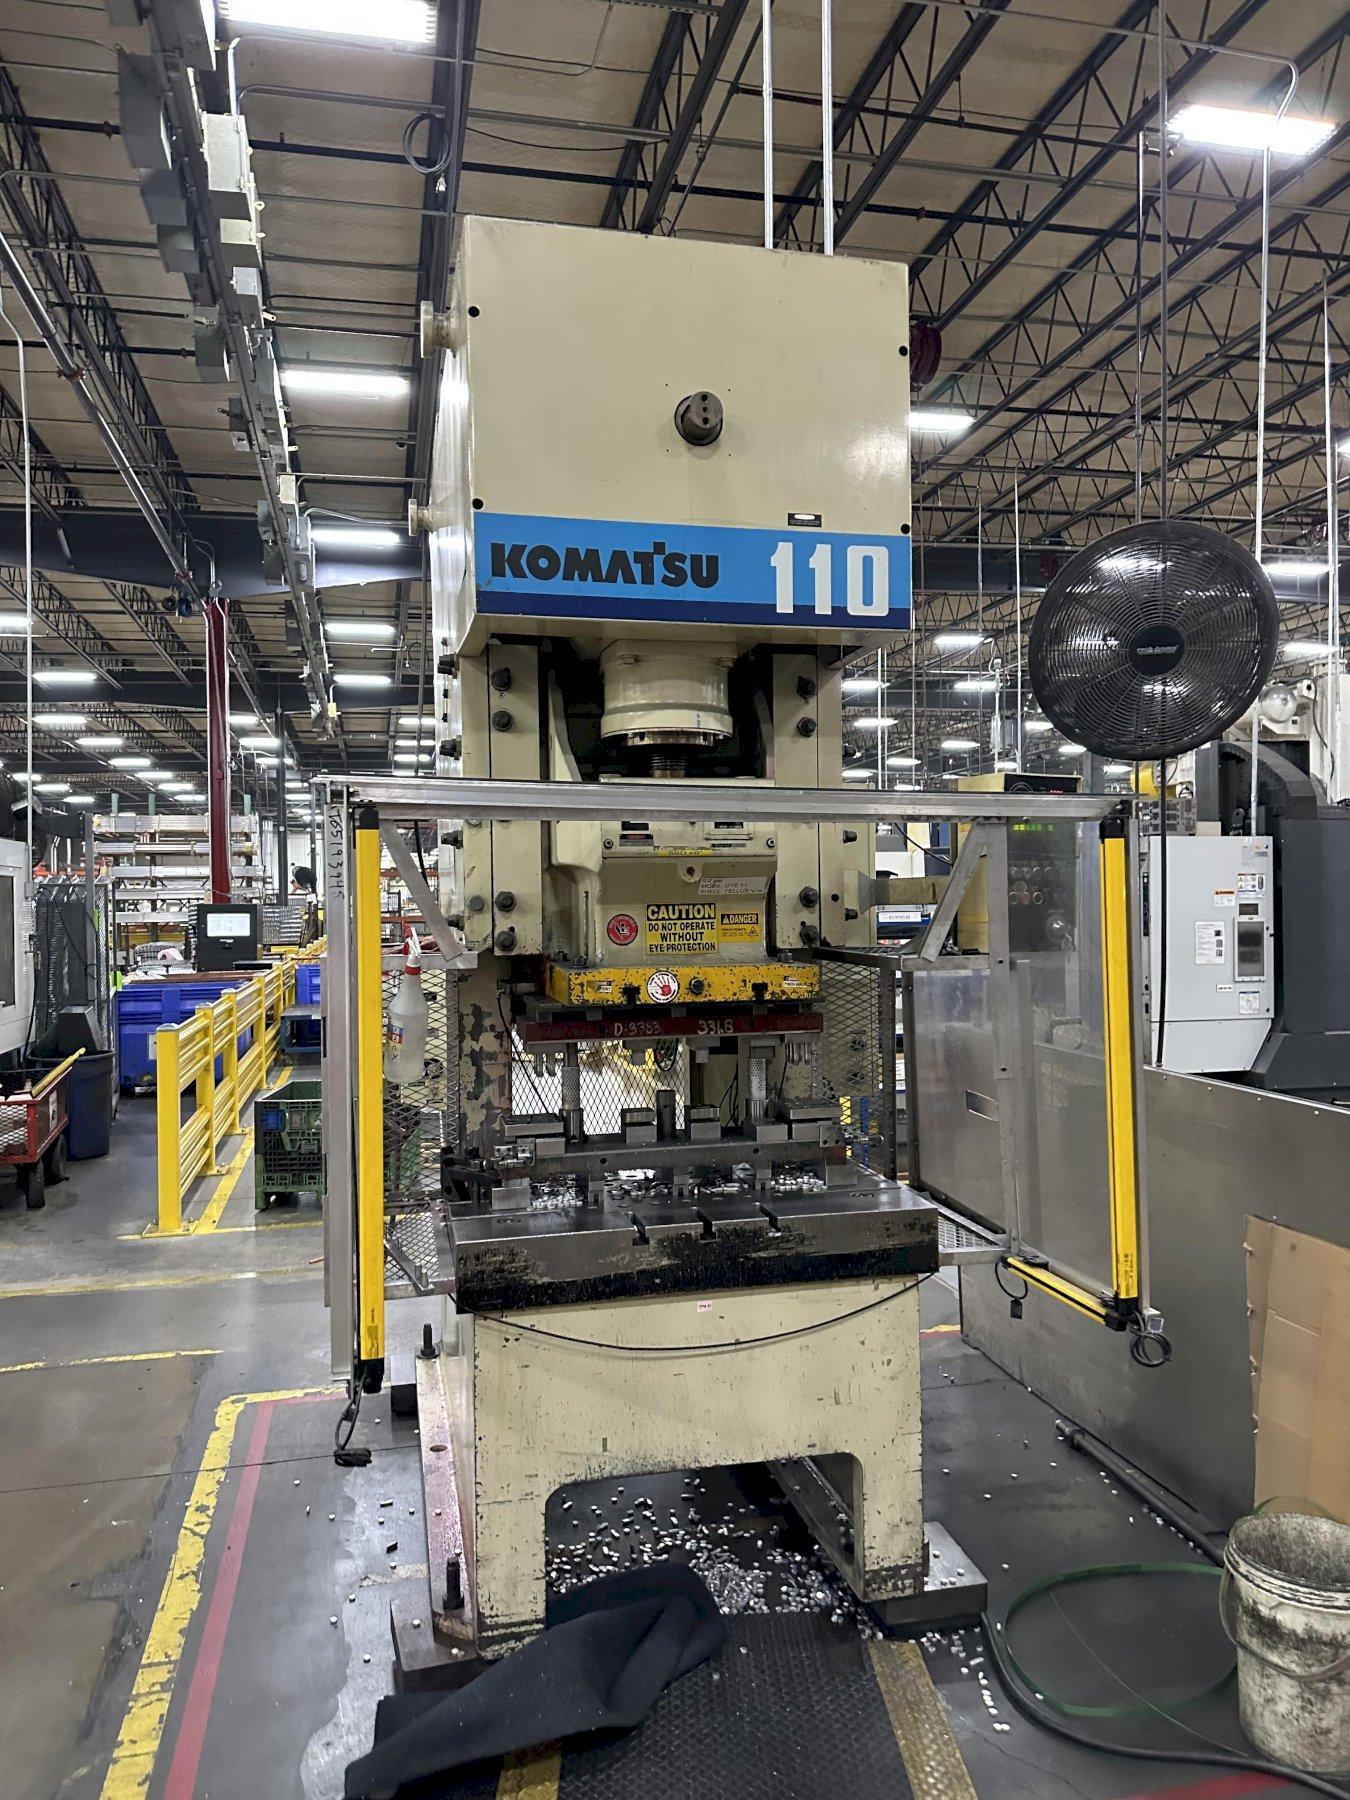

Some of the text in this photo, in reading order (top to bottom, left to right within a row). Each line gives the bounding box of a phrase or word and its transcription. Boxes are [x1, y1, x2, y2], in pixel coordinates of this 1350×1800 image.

[490, 541, 889, 617] KOMATSU 110
[647, 905, 715, 920] CAUTION
[729, 914, 757, 924] DANGER
[648, 921, 715, 932] DO NOT OPERATE
[660, 932, 704, 943] WITHOUT
[649, 942, 716, 953] EYE PROTECTION
